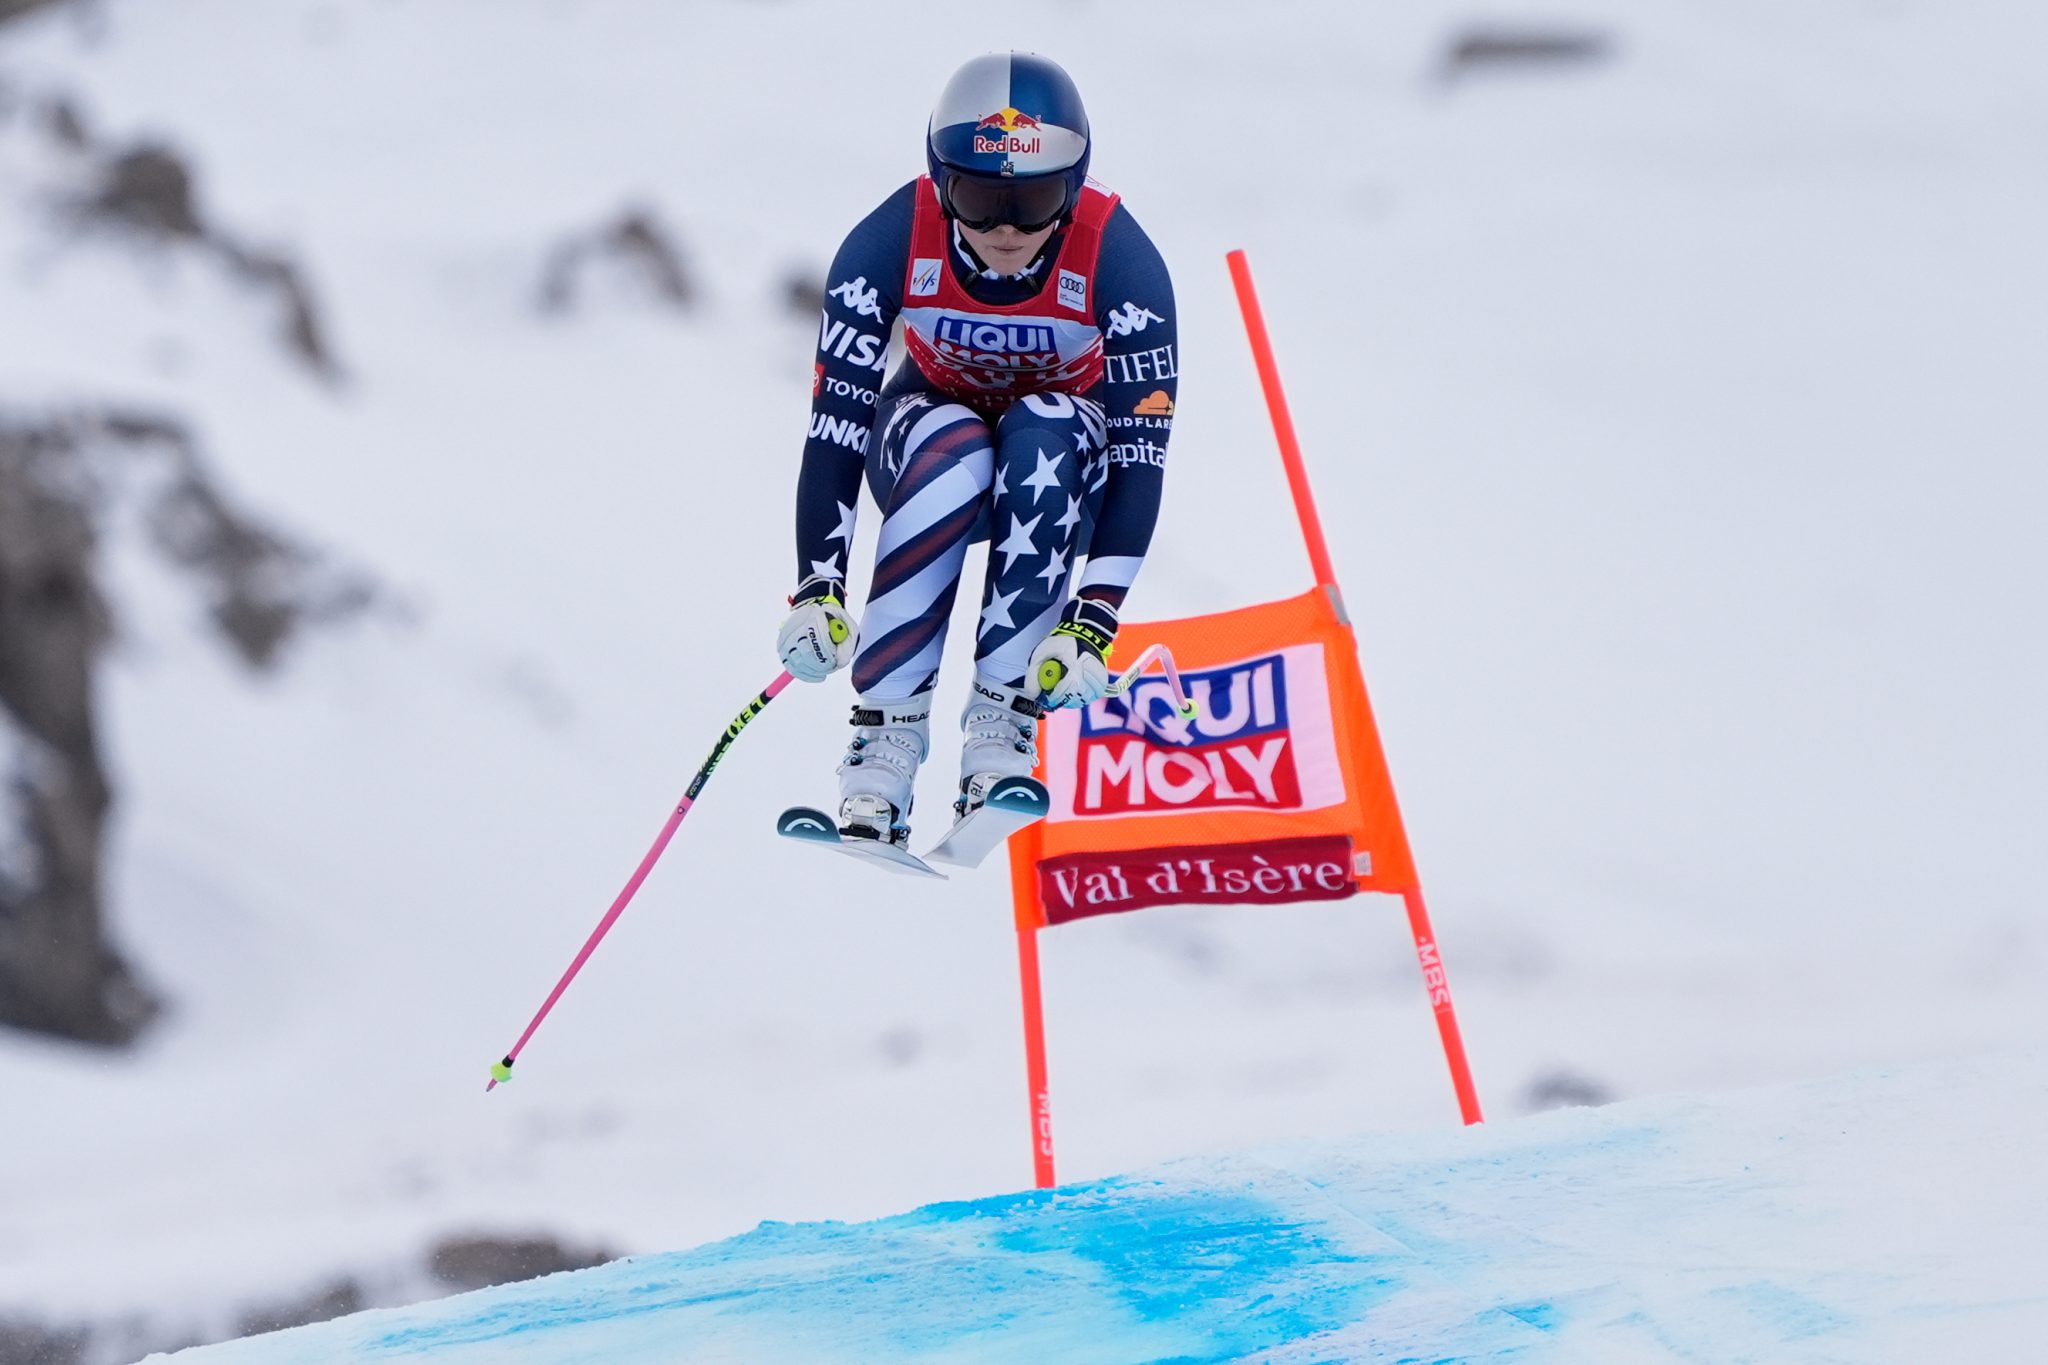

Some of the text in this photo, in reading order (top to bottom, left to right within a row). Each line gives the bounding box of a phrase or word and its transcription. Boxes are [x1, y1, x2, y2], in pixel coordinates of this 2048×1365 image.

[975, 135, 1040, 154] Red Bull
[940, 319, 1051, 353] LIQUI
[809, 411, 871, 457] UNKI
[1105, 416, 1172, 430] OUDFLARE
[1106, 437, 1169, 468] apita
[807, 626, 828, 664] reusch
[974, 681, 1005, 703] EAD
[1085, 737, 1288, 810] MOLY
[1051, 855, 1346, 909] Val d'Isère
